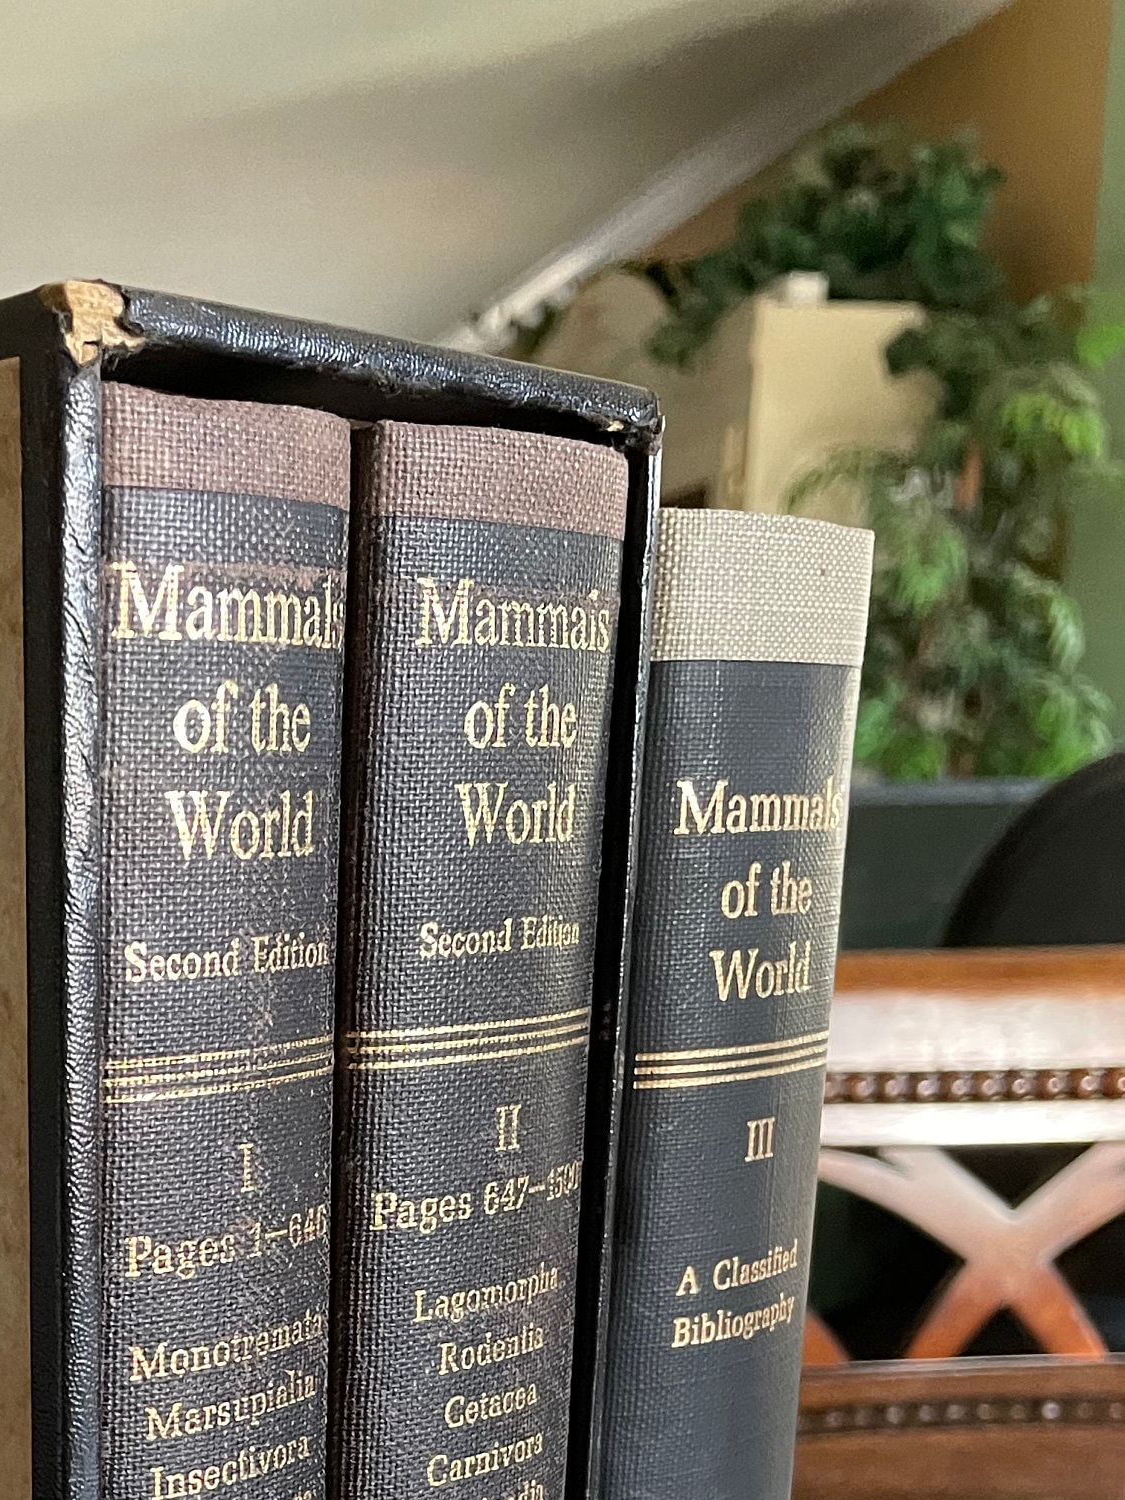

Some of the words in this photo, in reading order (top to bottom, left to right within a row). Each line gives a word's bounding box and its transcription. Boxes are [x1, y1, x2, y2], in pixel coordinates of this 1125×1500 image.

[415, 576, 609, 653] Mammals
[172, 680, 239, 753] of
[249, 684, 311, 751] the
[464, 683, 517, 749] of
[523, 684, 578, 749] the
[165, 791, 314, 860] World
[455, 781, 576, 848] World
[674, 775, 841, 835] Mammals
[721, 861, 761, 919] of
[770, 860, 813, 915] the
[125, 937, 240, 983] Second
[251, 931, 330, 973] Edition
[420, 918, 512, 960] Second
[521, 914, 579, 950] Edition
[709, 941, 811, 1001] World
[495, 1104, 522, 1151] II
[745, 1117, 775, 1162] III
[239, 1143, 255, 1192] I
[370, 1192, 472, 1234] Pages
[125, 1234, 234, 1279] Pages
[676, 1266, 701, 1296] A
[713, 1239, 797, 1291] Classified
[412, 1261, 558, 1323] Lagomorpha
[671, 1293, 795, 1347] Bibliography
[128, 1308, 322, 1381] Monotremata
[438, 1323, 544, 1375] Rodentia
[145, 1369, 315, 1441] Marsupialia
[444, 1383, 538, 1429] Cetacea
[150, 1435, 310, 1500] Insectivora
[427, 1431, 543, 1487] Carnivora
